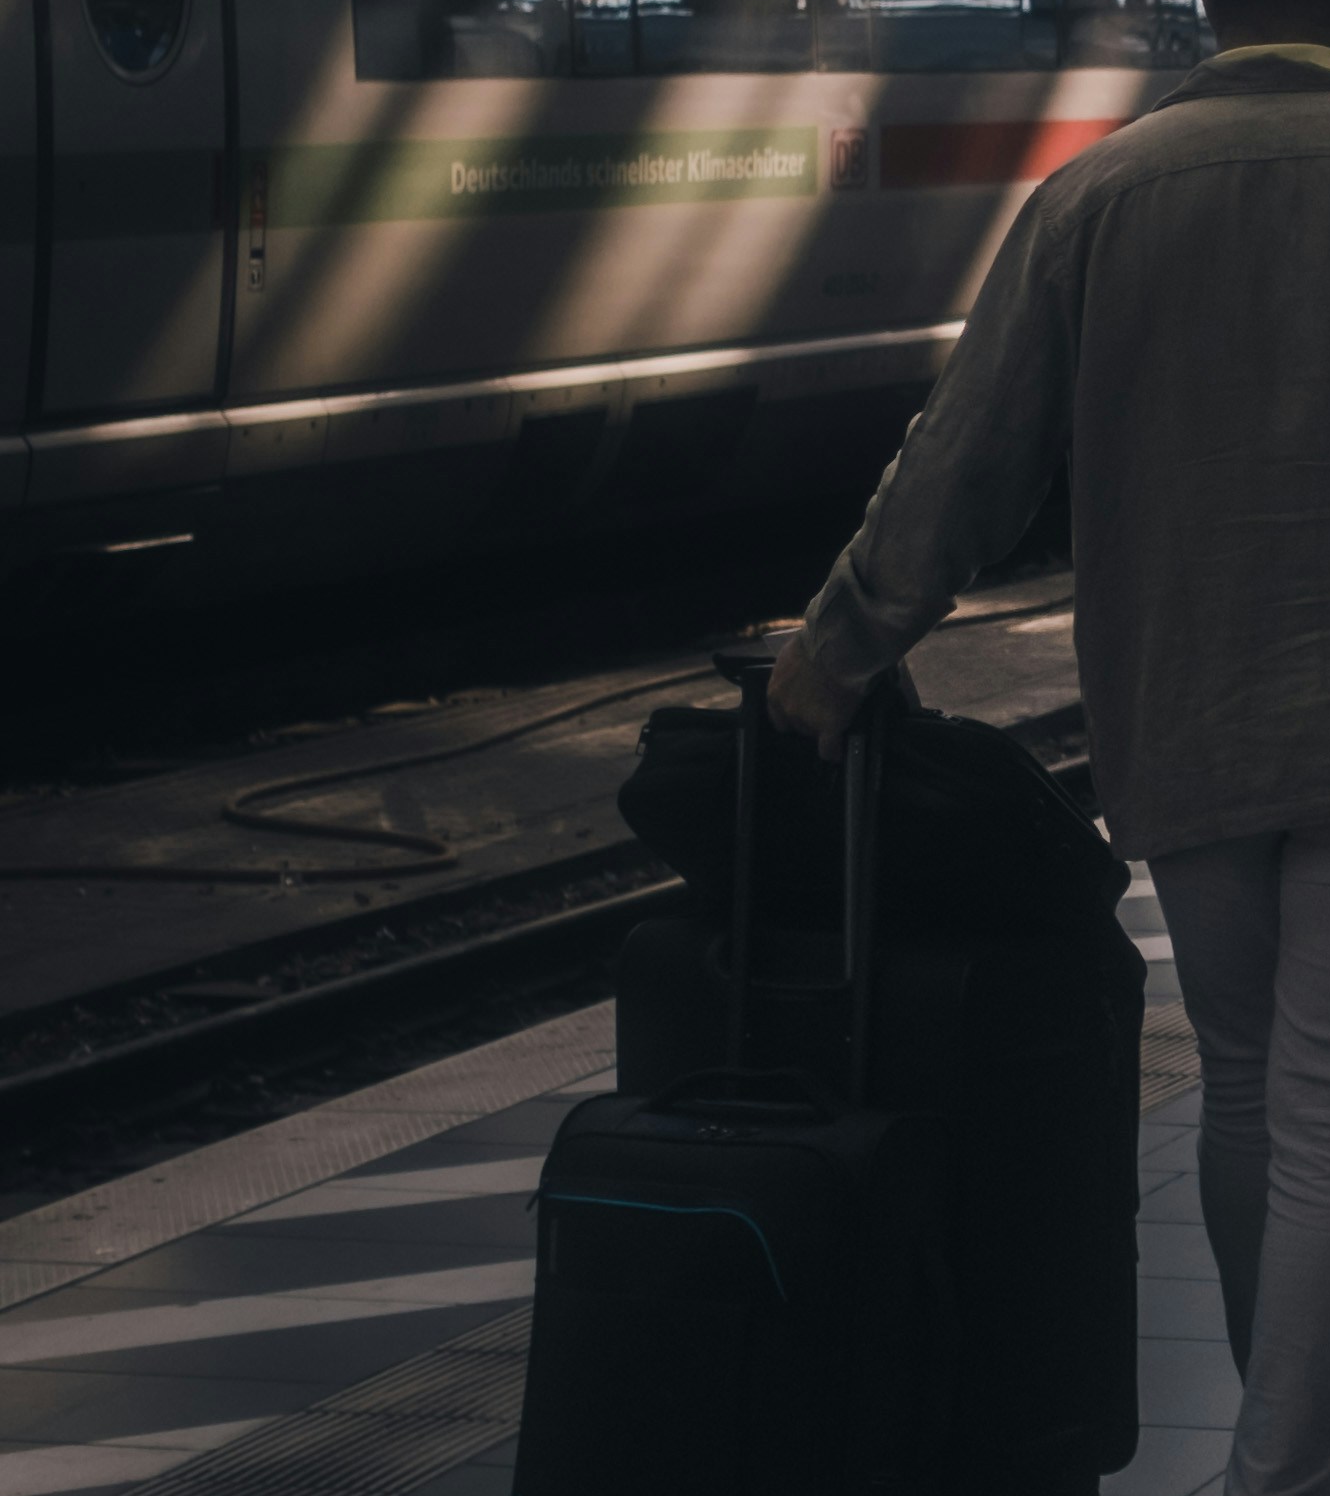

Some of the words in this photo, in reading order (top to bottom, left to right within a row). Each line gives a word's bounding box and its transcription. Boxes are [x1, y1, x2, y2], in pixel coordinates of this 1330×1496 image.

[451, 156, 581, 195] Deutschlands
[586, 151, 684, 188] schnellster
[687, 146, 806, 182] Klimaschützer
